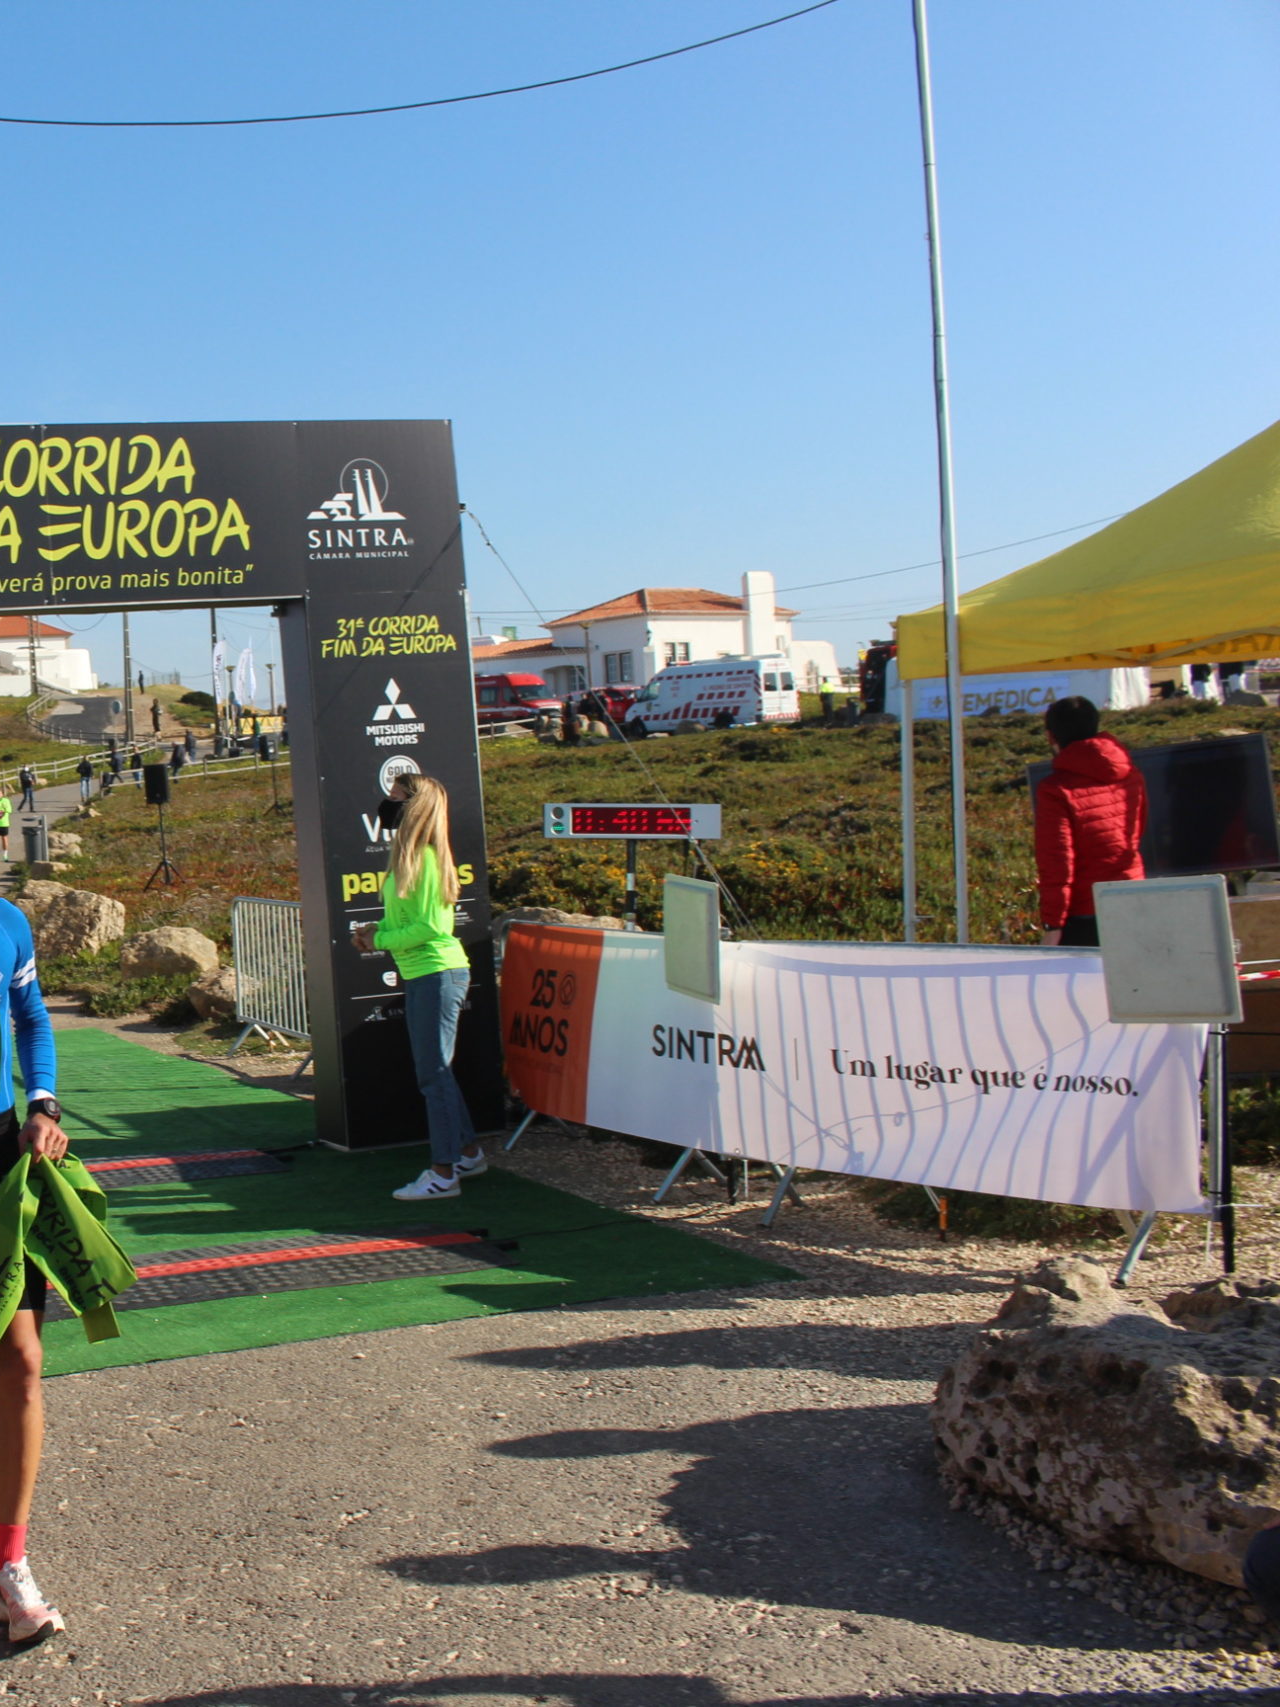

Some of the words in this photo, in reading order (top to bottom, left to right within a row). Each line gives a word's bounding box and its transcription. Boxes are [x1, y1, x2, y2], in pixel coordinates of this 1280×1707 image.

[37, 498, 251, 562] EUROPA
[307, 527, 408, 549] SINTRA
[355, 550, 409, 558] MUNICIPAL
[51, 572, 113, 596] prova
[120, 568, 170, 589] mais
[368, 614, 440, 635] CORRIDA
[321, 639, 357, 659] FIM
[360, 637, 386, 657] DA
[389, 634, 457, 655] EUROPA
[365, 722, 425, 736] MITSUBISHI
[374, 734, 418, 746] MOTORS
[530, 969, 557, 1008] 25
[652, 1024, 765, 1071] SINTRA
[830, 1049, 876, 1077] Um
[885, 1055, 962, 1090] lugar
[970, 1068, 1025, 1095] que
[1053, 1074, 1139, 1097] nosso.
